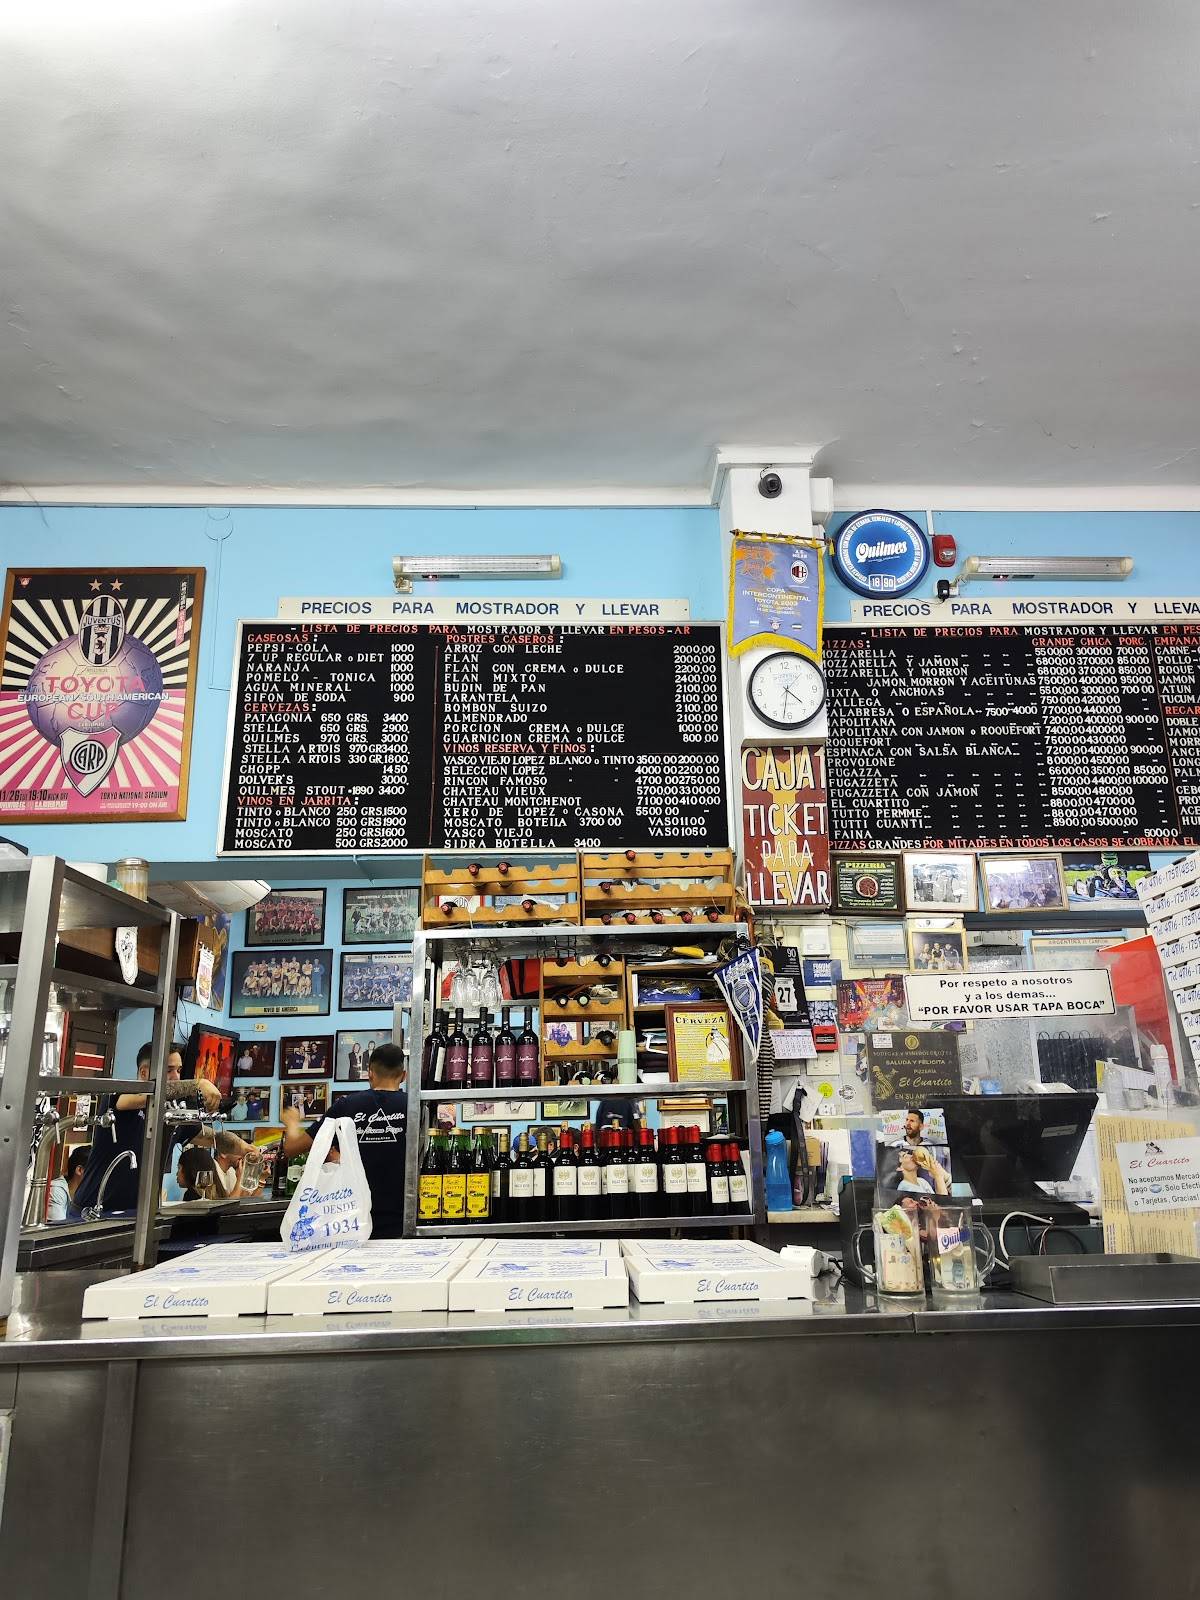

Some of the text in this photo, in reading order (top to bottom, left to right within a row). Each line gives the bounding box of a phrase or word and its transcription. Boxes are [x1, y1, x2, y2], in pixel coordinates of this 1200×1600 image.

[856, 541, 907, 563] Quilmes
[742, 590, 811, 602] INTERCONTINENTAL
[302, 602, 659, 615] PRECIOS PARA MOSTRADOR Y LLEVAR
[863, 605, 930, 617] PRECIOS
[952, 604, 992, 616] PARA
[1012, 603, 1113, 614] MOSTRADOR
[1128, 603, 1138, 614] Y
[82, 616, 123, 626] JUVENTUS
[347, 625, 360, 633] DE
[369, 625, 418, 633] PRECIOS
[429, 625, 458, 633] PARA
[467, 626, 541, 634] MOSTRADOR
[548, 626, 555, 634] Y
[561, 626, 605, 635] LLEVAR
[610, 626, 624, 634] EN
[1032, 638, 1112, 646] GRANDE CHICA
[391, 644, 414, 652] 1000
[248, 654, 253, 662] 7
[263, 654, 278, 662] UP
[287, 654, 341, 662] REGULAR
[357, 654, 384, 662] DIET
[391, 654, 414, 662] 1000
[247, 664, 310, 672] NARANJA
[46, 677, 144, 693] TOYOTA
[244, 683, 351, 692] AGUA MINERAL
[812, 685, 817, 693] 9
[1162, 685, 1191, 693] ATUN
[890, 687, 944, 697] ANCHOAS
[244, 693, 414, 702] SIFON DE SODA 900
[445, 694, 518, 702] TARANTELA
[68, 703, 118, 720] CUP
[444, 704, 547, 712] BOMBON SUIZO
[445, 714, 527, 722] ALMENDRADO
[243, 734, 408, 743] QUILMES 970 3000
[443, 744, 547, 753] VINOS RESERVA Y
[828, 758, 895, 767] PROVOLONE
[742, 746, 814, 791] CAJA
[29, 790, 47, 800] 19:10
[831, 787, 979, 798] FUGAZZETA CON JAMON
[443, 797, 581, 806] CHATEAU MONTCHENOT
[853, 798, 909, 808] CUARTITO
[237, 807, 357, 816] TINTO BLANCO 250
[744, 803, 827, 837] TICKET
[832, 819, 923, 829] TUTTI CUANTI
[235, 839, 408, 848] MOSCATO 500 2000
[445, 838, 600, 848] SIDRA BOTELLA 3400
[868, 838, 1109, 849] GRANDES MITADES TODOS CASOS
[762, 840, 814, 868] PARA
[746, 871, 831, 905] LLEVAR
[787, 949, 796, 957] 90
[940, 980, 959, 988] Por
[963, 978, 1007, 988] respeto
[1022, 976, 1072, 985] nosotros
[778, 987, 790, 1003] 27
[965, 994, 970, 1002] y
[986, 991, 1002, 999] los
[1006, 990, 1056, 998] demas...
[953, 1005, 992, 1014] FAVOR
[996, 1004, 1028, 1012] USAR
[1032, 1002, 1063, 1011] TAPA
[899, 1077, 952, 1087] El Cuartito
[354, 1112, 405, 1122] El Cuartito
[1130, 1158, 1190, 1168] El Cuartito
[1131, 1186, 1147, 1194] pago
[323, 1201, 358, 1214] DESDE
[324, 1217, 359, 1236] 1934
[698, 1279, 759, 1294] El Cuartito
[328, 1290, 392, 1305] El Cuartito
[508, 1287, 573, 1301] El Cuartito
[144, 1295, 209, 1310] El Cuartito
